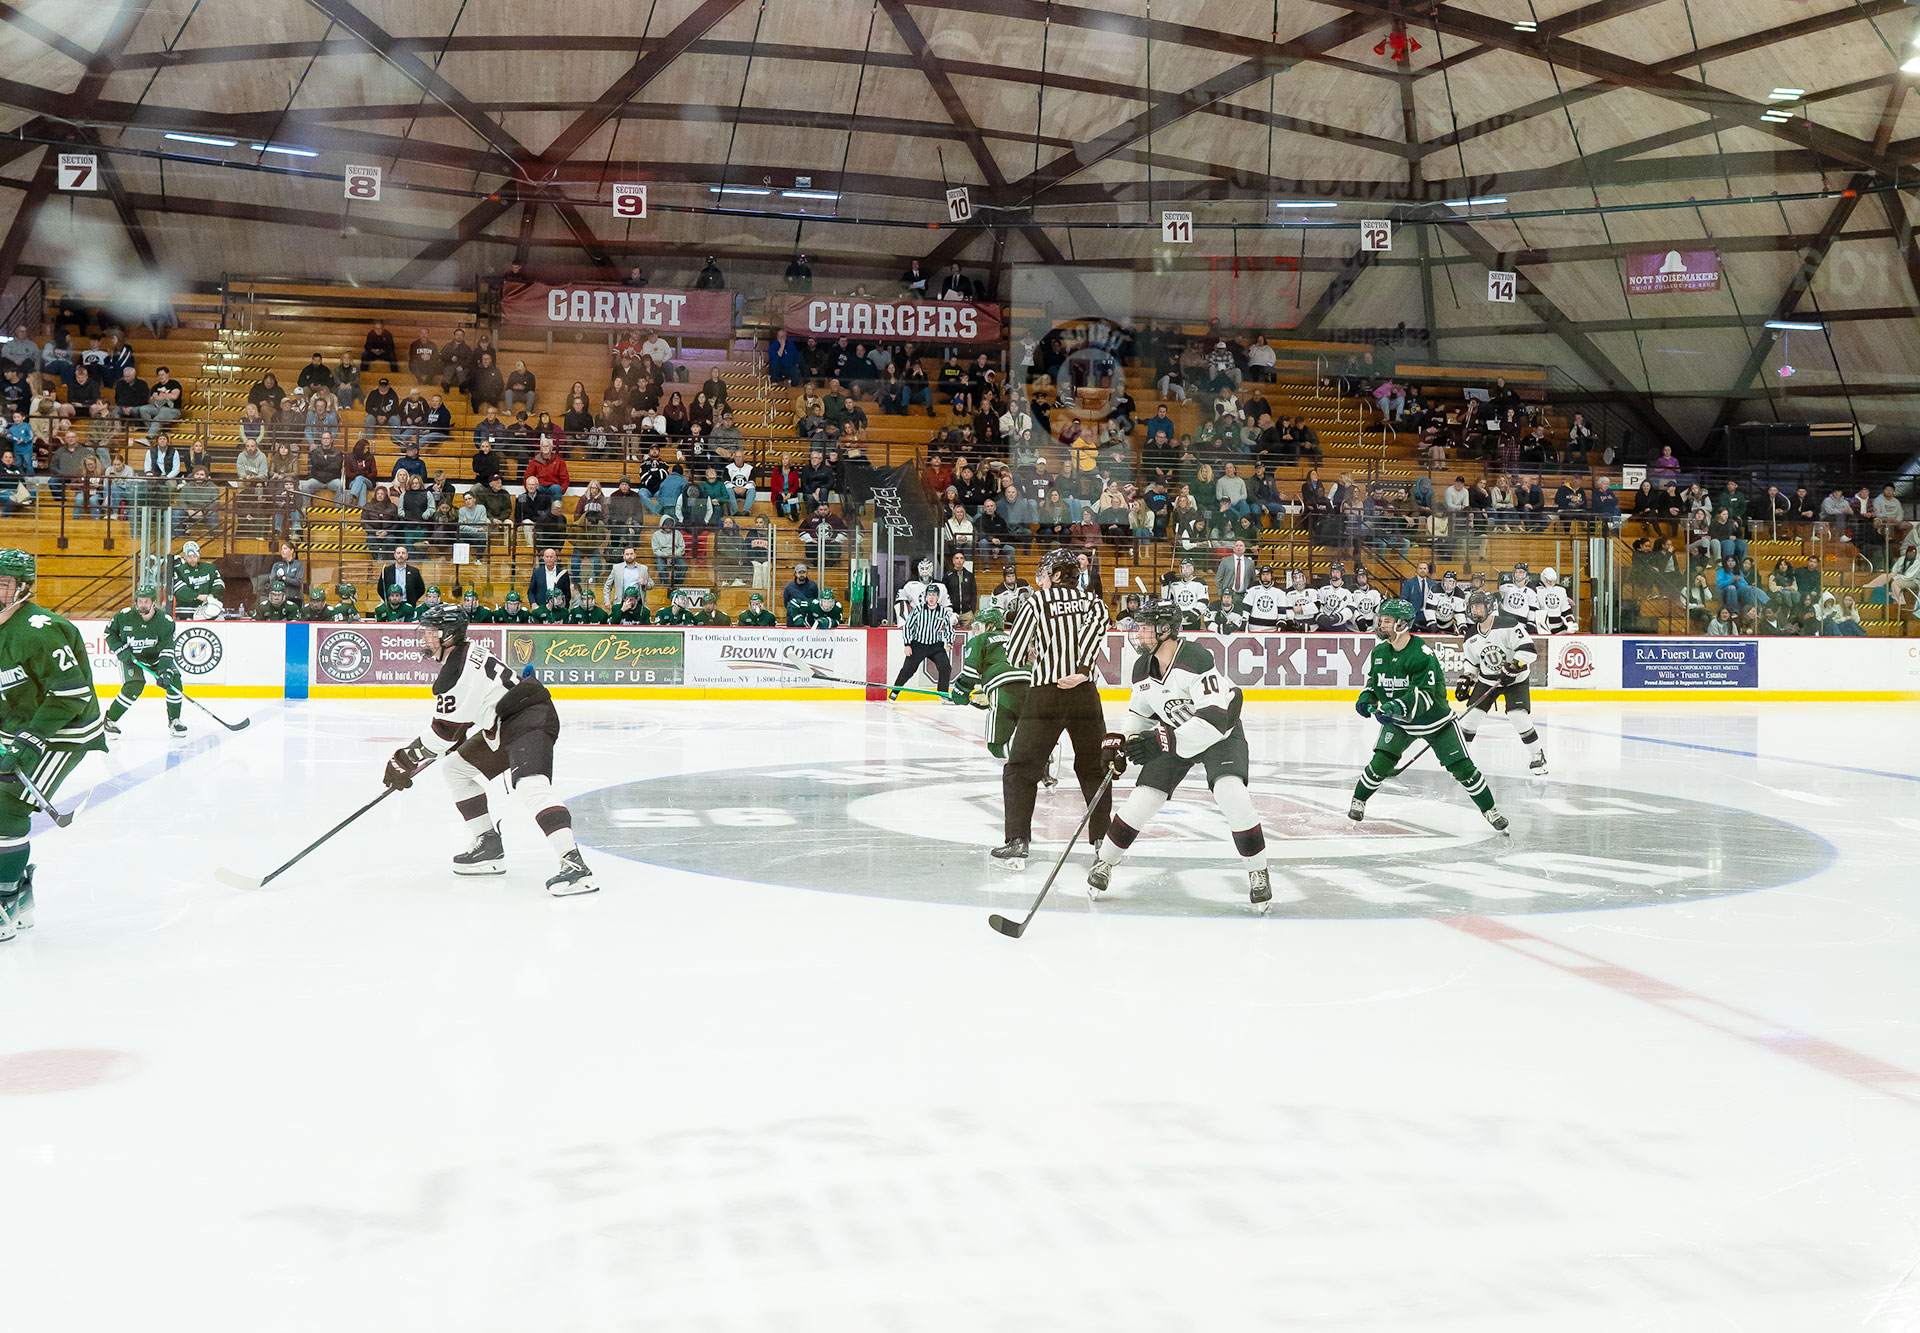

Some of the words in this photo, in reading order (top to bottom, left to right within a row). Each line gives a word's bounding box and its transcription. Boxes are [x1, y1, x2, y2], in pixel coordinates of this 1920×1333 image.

[61, 155, 94, 165] SECTION
[64, 166, 92, 187] 7
[348, 167, 378, 176] SECTION
[349, 176, 377, 198] 8
[615, 186, 644, 194] SECTION
[617, 195, 643, 215] 9
[950, 198, 970, 219] 10
[1164, 213, 1190, 221] SECTION
[1166, 221, 1190, 241] 11
[1363, 221, 1389, 229] SECTION
[1365, 230, 1390, 249] 12
[1490, 272, 1514, 281] SECTION
[1629, 276, 1653, 285] NOTT
[1655, 272, 1718, 283] NOISEMAKERS
[1490, 281, 1514, 301] 14
[548, 289, 687, 326] GARNET
[808, 301, 977, 338] CHARGERS
[1631, 477, 1639, 485] P
[690, 634, 704, 642] The
[705, 634, 732, 642] Official
[733, 634, 760, 642] Charter
[762, 635, 795, 644] Company
[1515, 628, 1524, 639] 3
[324, 633, 368, 650] SCHENECTADY
[381, 635, 428, 648] Schene
[52, 645, 78, 671] 29
[380, 650, 424, 663] Hockey
[545, 639, 591, 665] Katie
[720, 644, 777, 659] BROWN
[783, 644, 833, 660] COACH
[1487, 652, 1499, 665] U
[1636, 649, 1658, 660] R.A.
[1661, 649, 1690, 660] Fuerst
[1692, 649, 1713, 660] Law
[1715, 649, 1745, 662] Group
[321, 655, 329, 663] 19
[1180, 636, 1376, 686] CKEY
[1566, 652, 1584, 667] 50
[328, 667, 364, 680] CHARGERS
[375, 670, 393, 681] Work
[397, 670, 412, 681] hard.
[414, 670, 429, 682] Play
[535, 670, 595, 682] IRISH
[615, 670, 656, 682] PUB
[692, 676, 736, 684] Amsterdam,
[1427, 670, 1436, 685] 3
[1201, 674, 1219, 695] 10
[436, 694, 456, 713] 22
